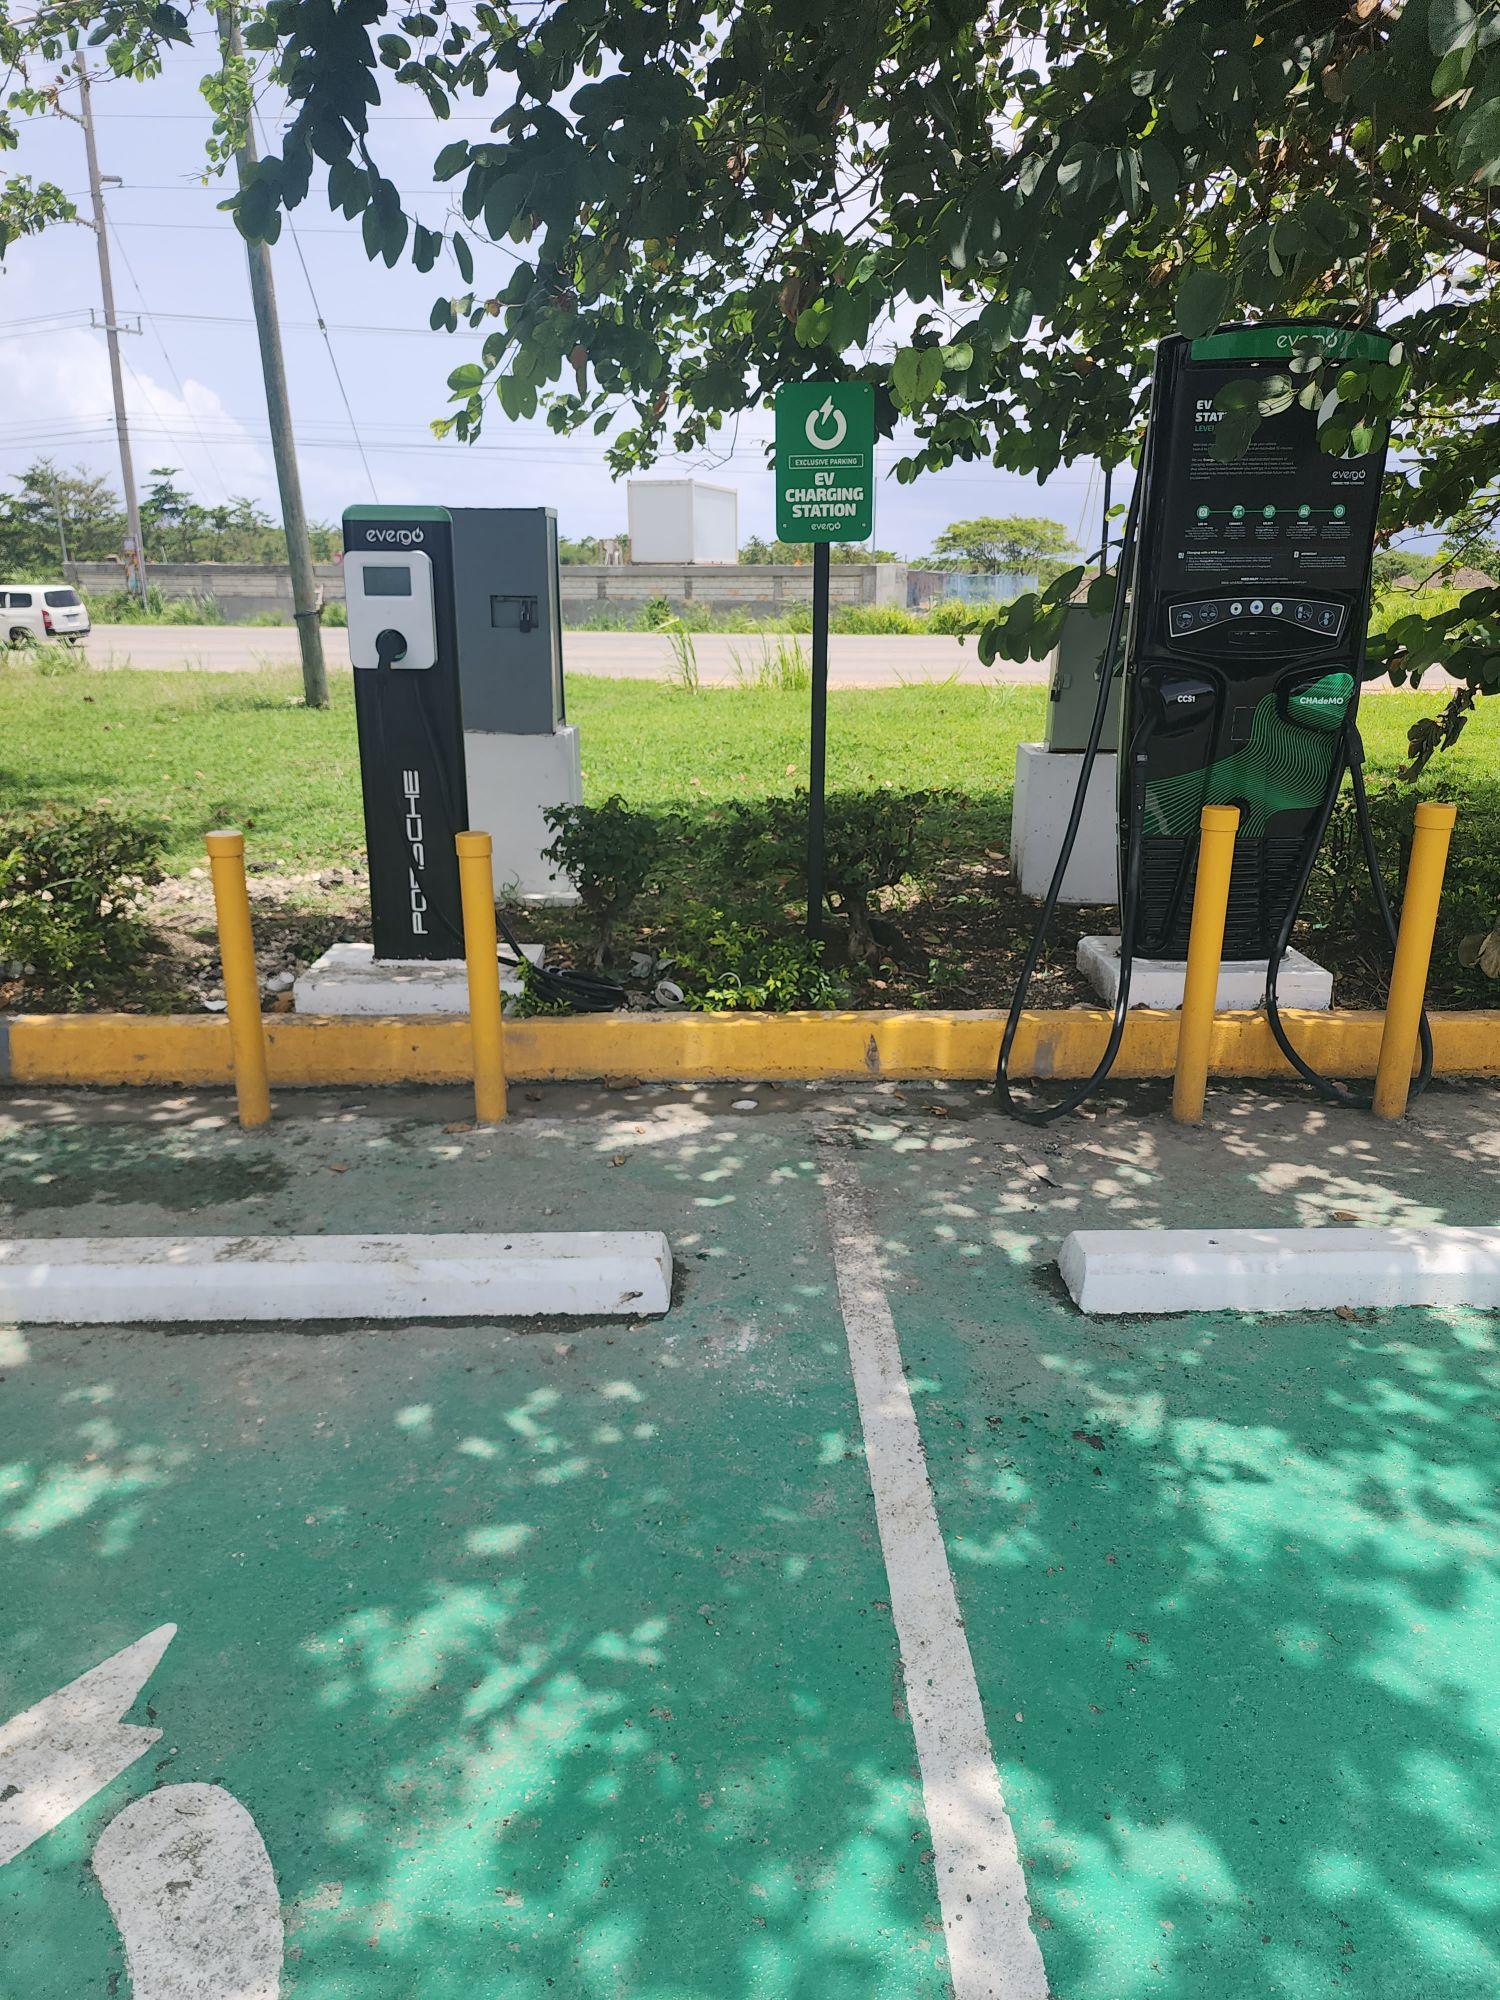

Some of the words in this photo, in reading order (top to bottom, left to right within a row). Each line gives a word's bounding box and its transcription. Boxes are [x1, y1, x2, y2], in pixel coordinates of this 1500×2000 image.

[1276, 332, 1338, 349] evo
[1196, 399, 1213, 410] EV
[795, 458, 829, 466] EXCLUSIVE
[829, 457, 858, 465] PARKING
[814, 472, 835, 486] EV
[1331, 469, 1366, 481] evergo
[785, 487, 864, 502] CHARGING
[792, 503, 857, 518] STATION
[810, 521, 842, 532] evergo
[365, 526, 425, 545] evergo
[1177, 695, 1196, 703] CCS1
[1299, 696, 1344, 705] CHAdeMO
